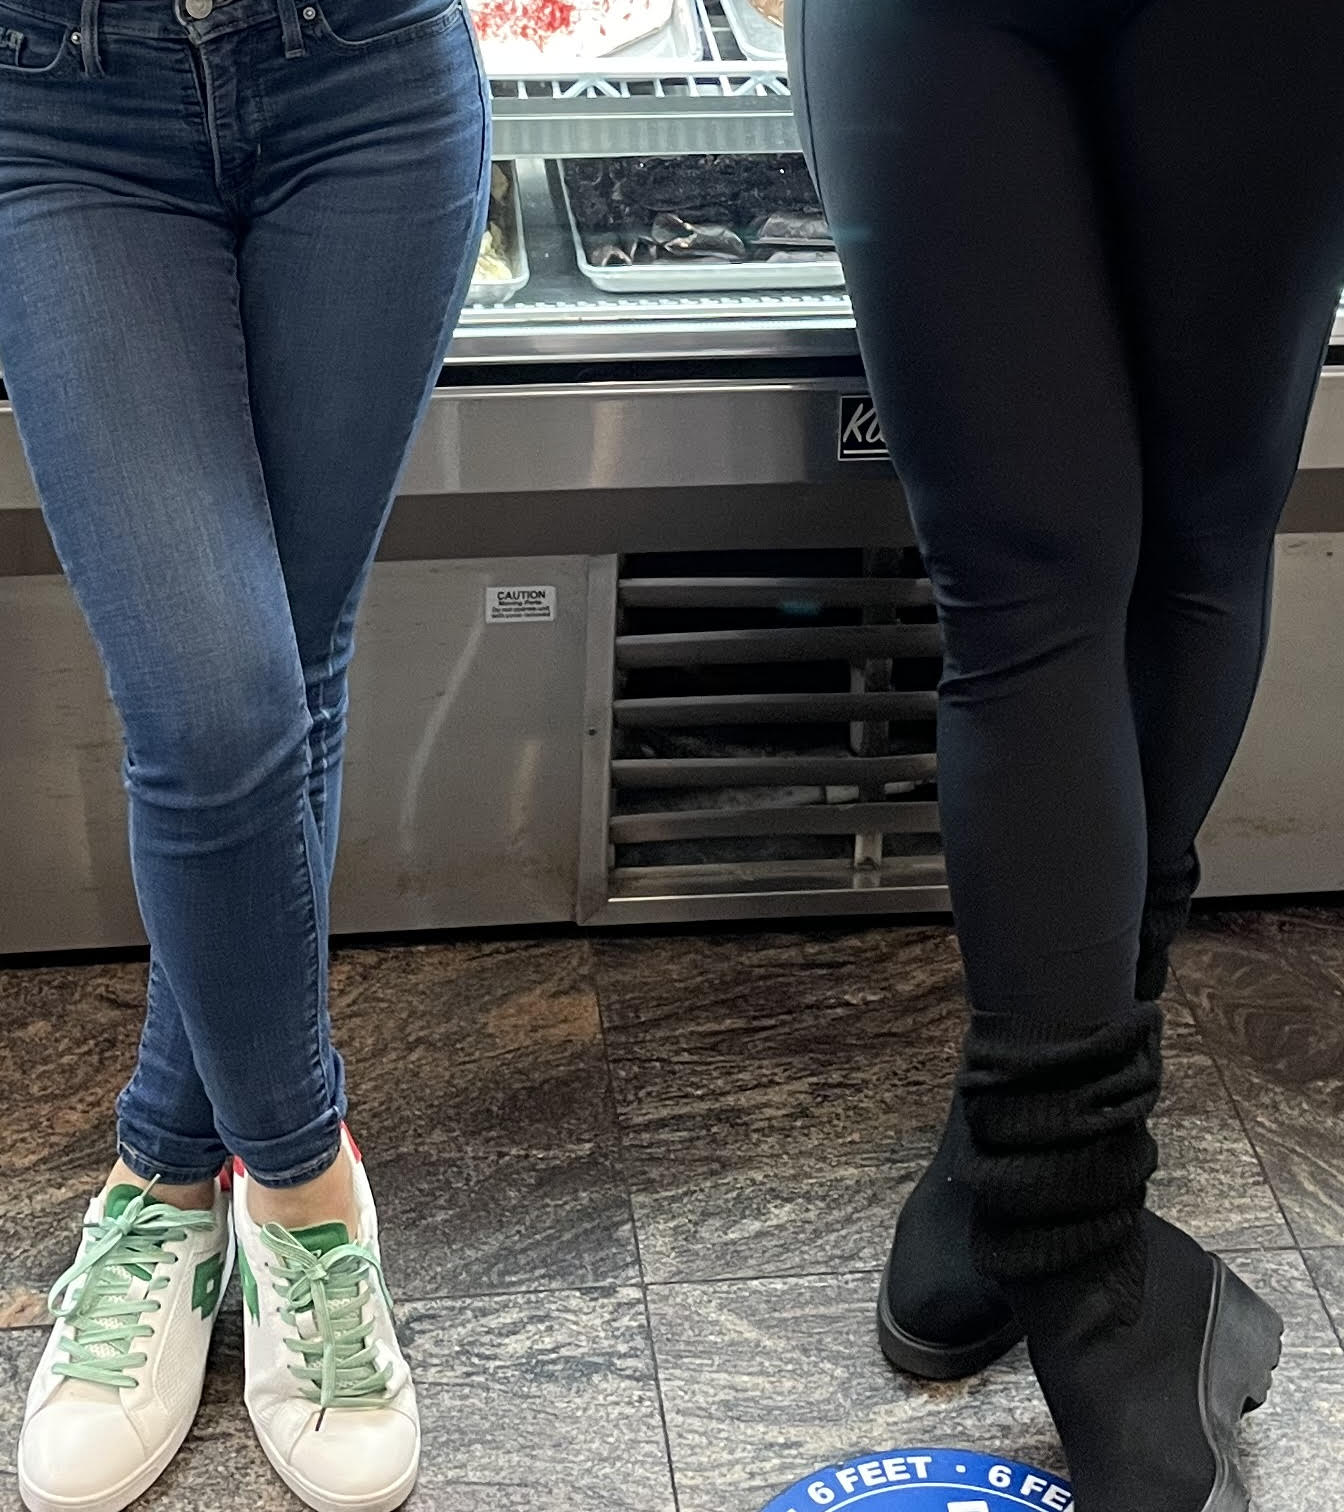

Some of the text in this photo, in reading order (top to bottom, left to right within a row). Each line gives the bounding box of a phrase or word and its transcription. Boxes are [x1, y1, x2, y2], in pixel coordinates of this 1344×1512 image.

[497, 590, 546, 600] CAUTION
[807, 1480, 835, 1505] 6
[835, 1456, 932, 1494] FEET
[988, 1465, 1012, 1488] 6
